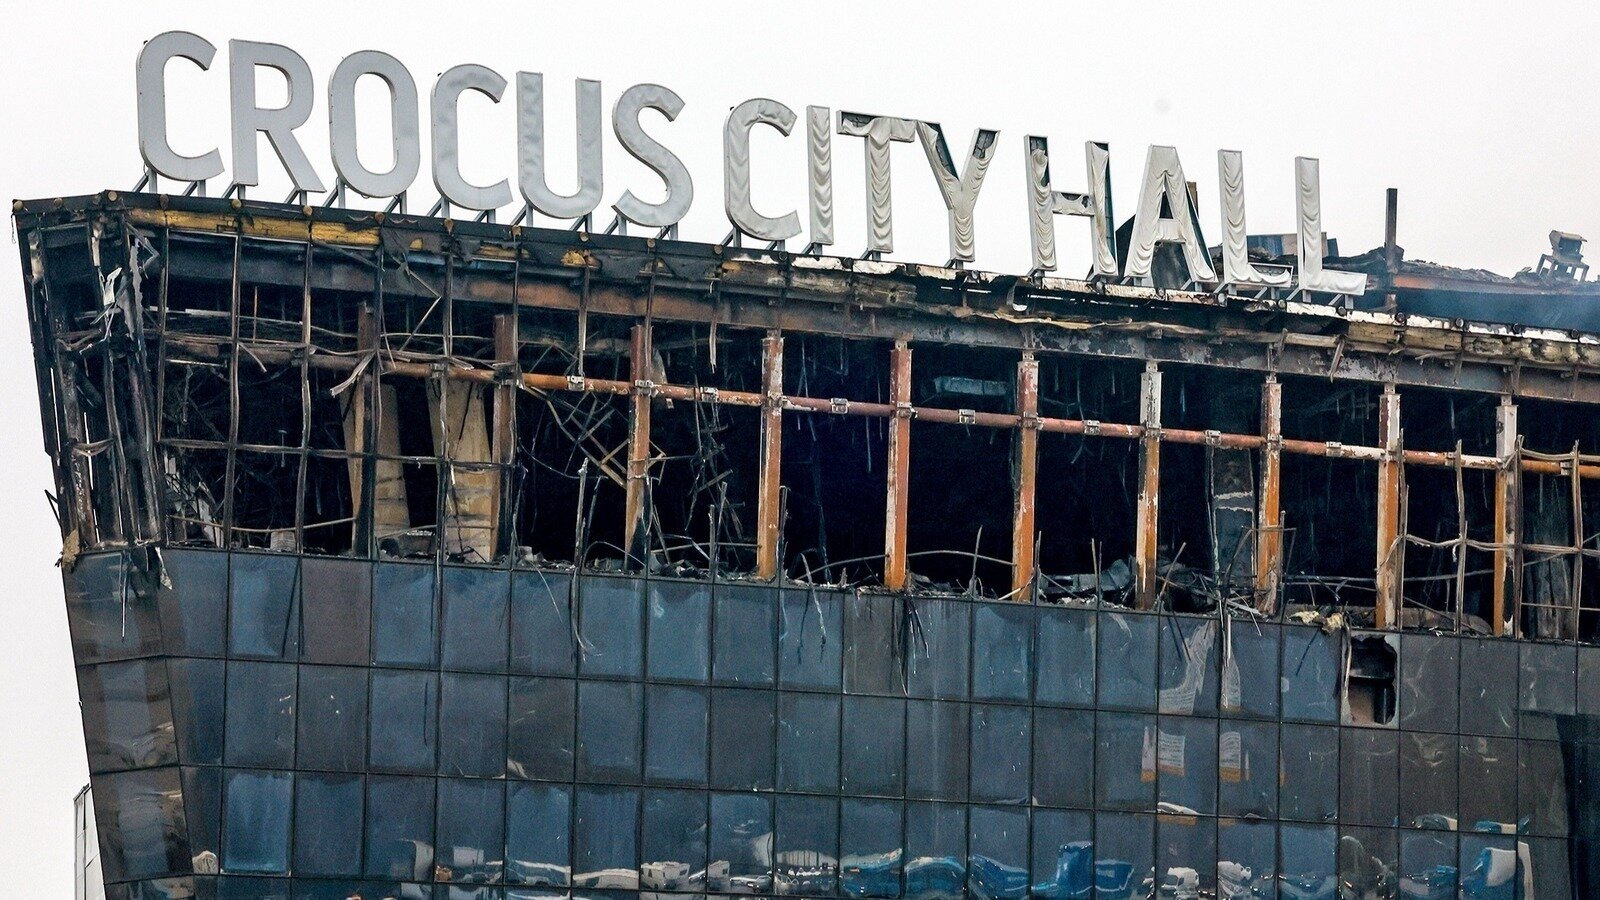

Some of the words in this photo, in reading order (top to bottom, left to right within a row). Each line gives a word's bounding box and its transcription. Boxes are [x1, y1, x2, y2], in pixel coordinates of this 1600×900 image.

[136, 30, 694, 228] CROCUS
[723, 97, 1000, 264] CITY
[1024, 134, 1366, 296] HALL
